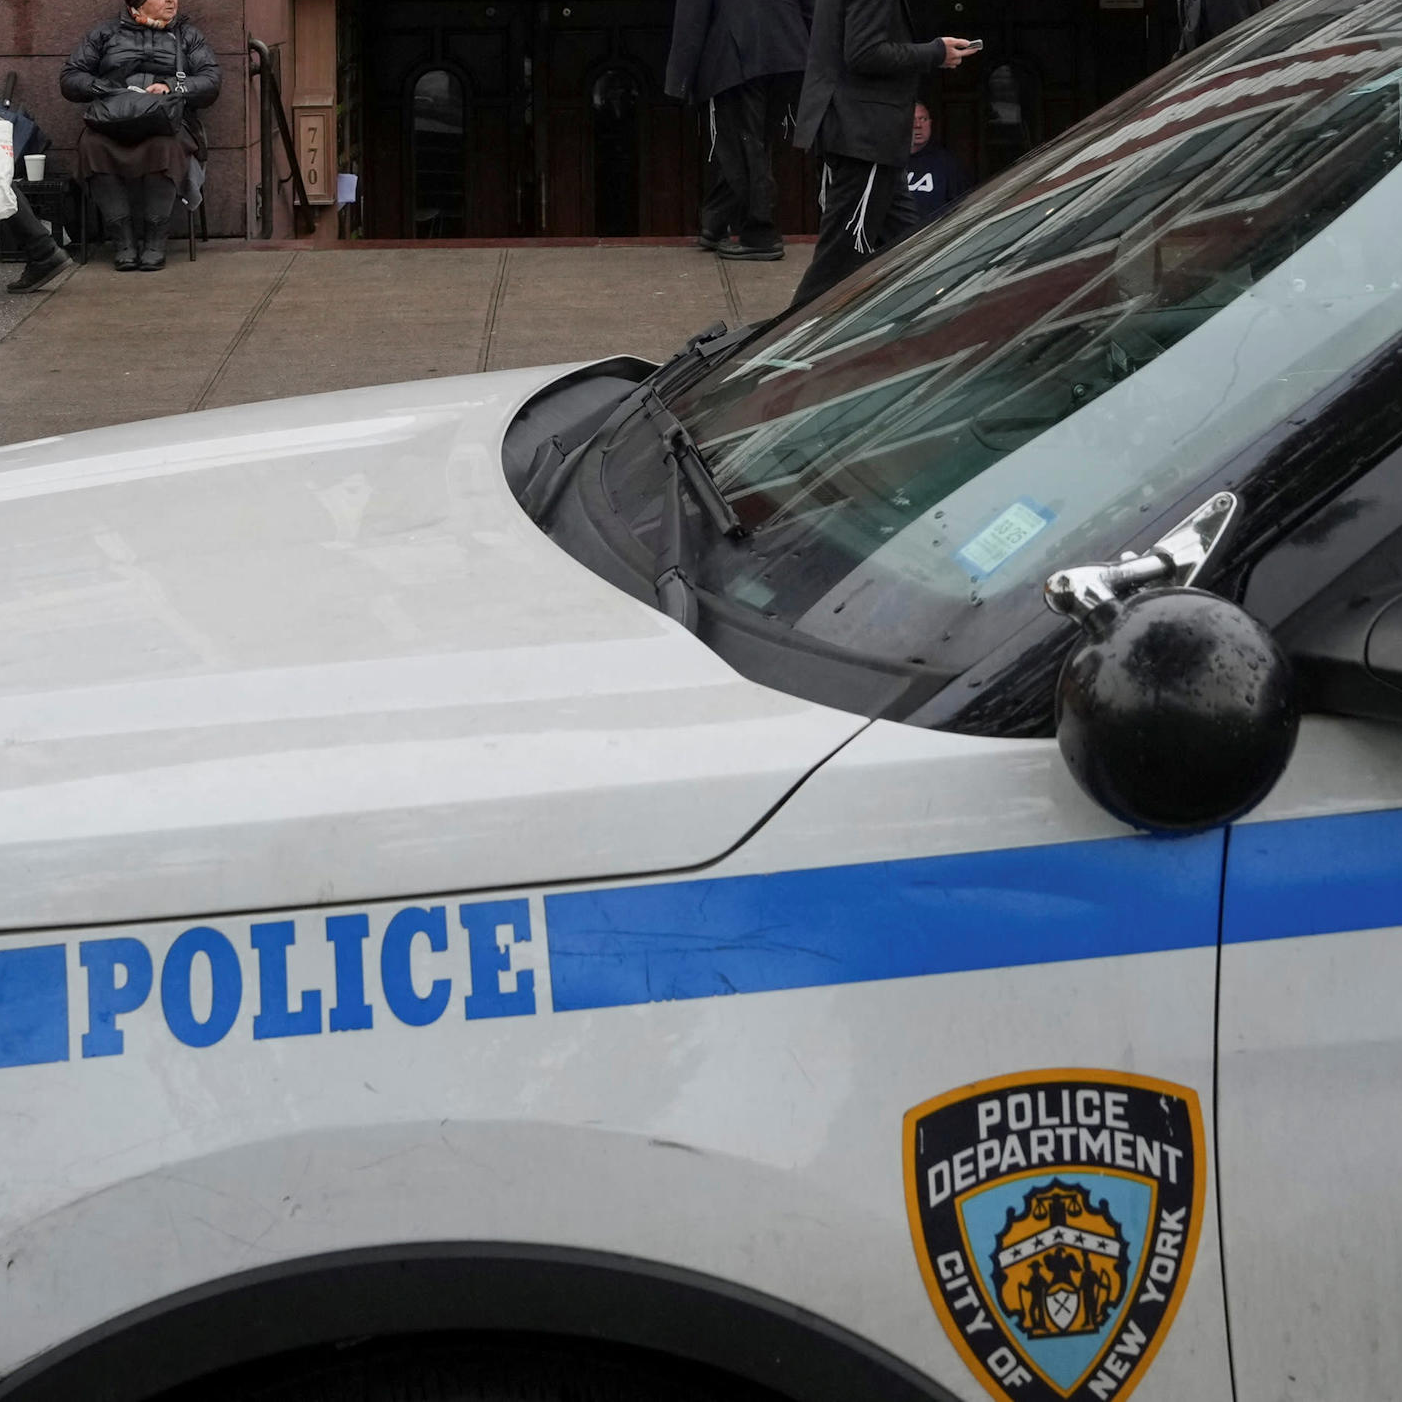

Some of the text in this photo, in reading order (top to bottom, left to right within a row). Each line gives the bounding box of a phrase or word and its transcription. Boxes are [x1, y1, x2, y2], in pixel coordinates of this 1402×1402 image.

[307, 127, 318, 185] 770
[80, 898, 536, 1058] POLICE
[926, 1127, 1183, 1209] DEPARTMENT
[978, 1089, 1129, 1140] POLICE
[936, 1250, 1032, 1389] CITY OF
[1087, 1205, 1187, 1401] NEW YORK
